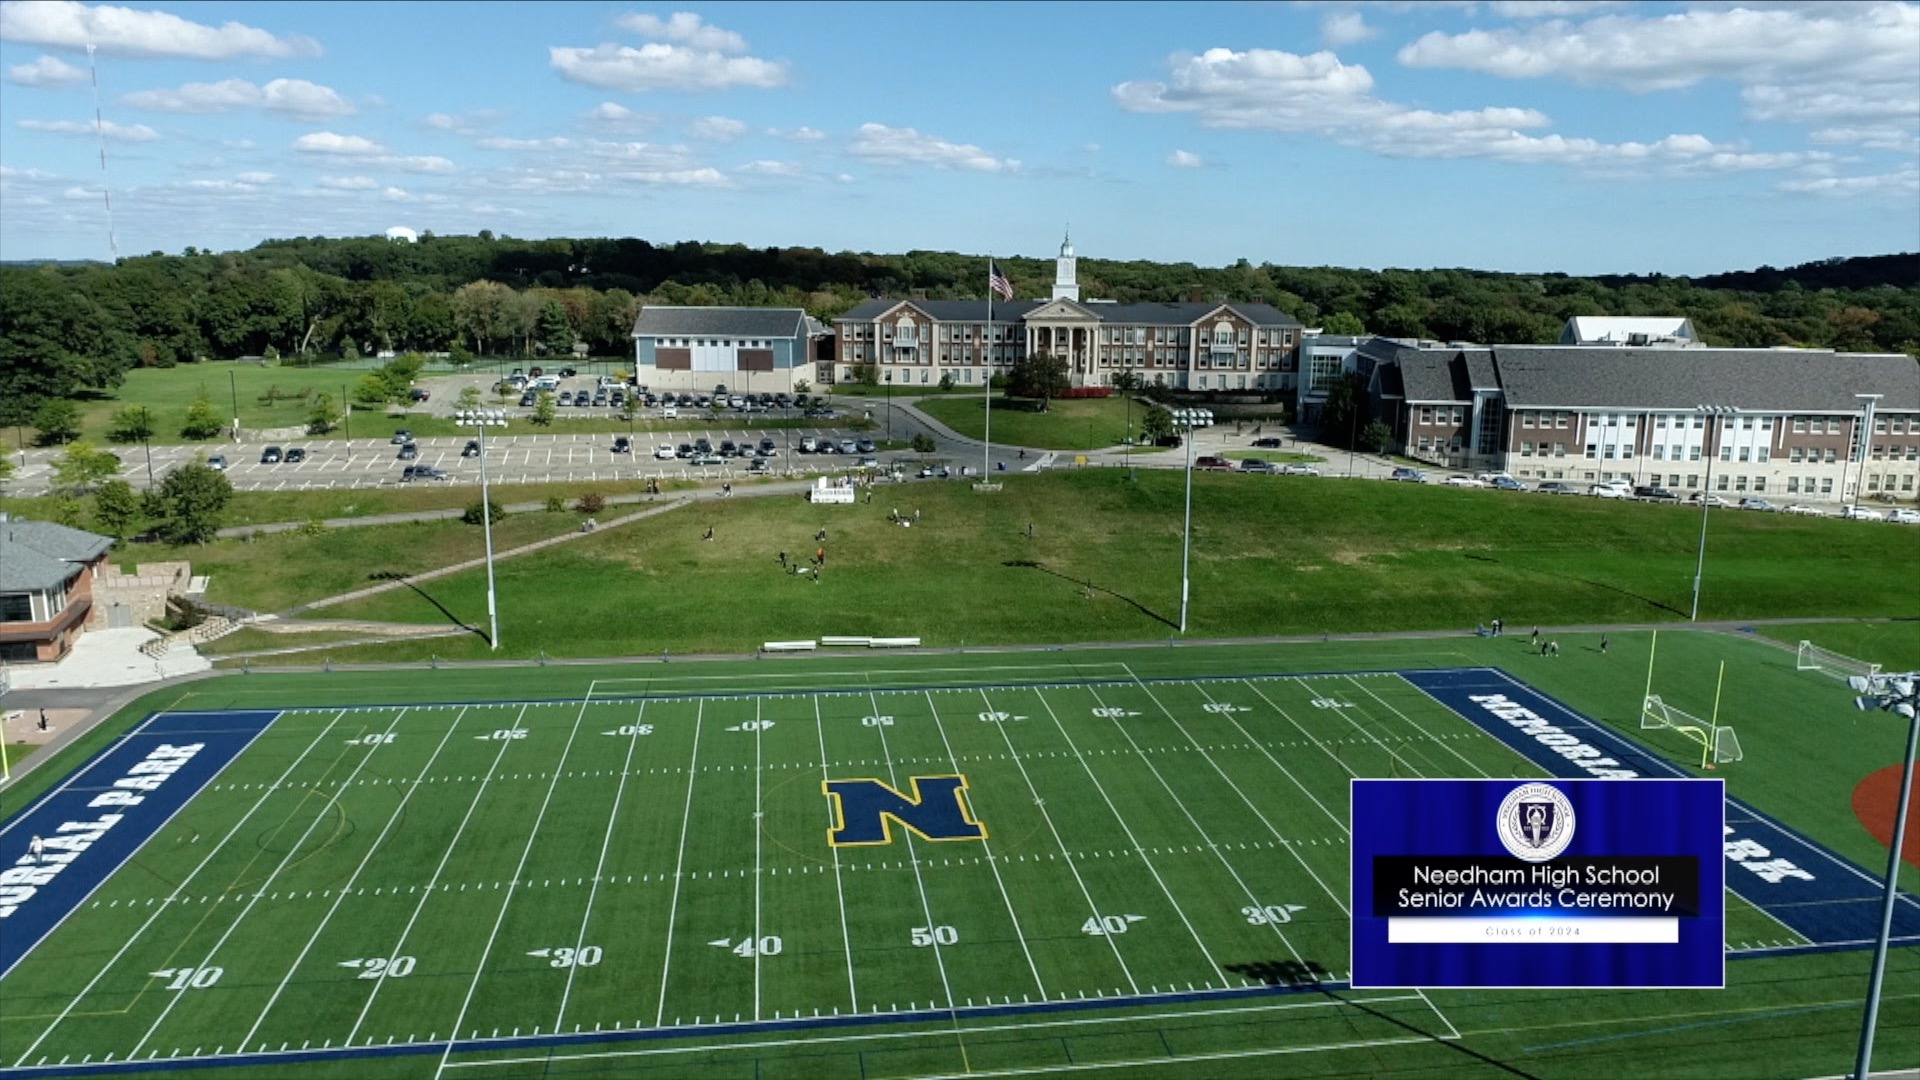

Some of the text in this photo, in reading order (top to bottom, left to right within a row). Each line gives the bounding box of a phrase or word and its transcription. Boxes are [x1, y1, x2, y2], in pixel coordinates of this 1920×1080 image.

[862, 716, 895, 727] 50
[87, 742, 206, 808] PARK
[1468, 693, 1816, 883] MEMORIA RK
[822, 774, 988, 846] N
[1081, 915, 1128, 935] 40
[1240, 904, 1291, 926] 30
[732, 935, 782, 957] 40
[911, 926, 959, 947] 50
[357, 956, 416, 979] 20
[550, 946, 602, 968] 30
[165, 967, 223, 989] 10
